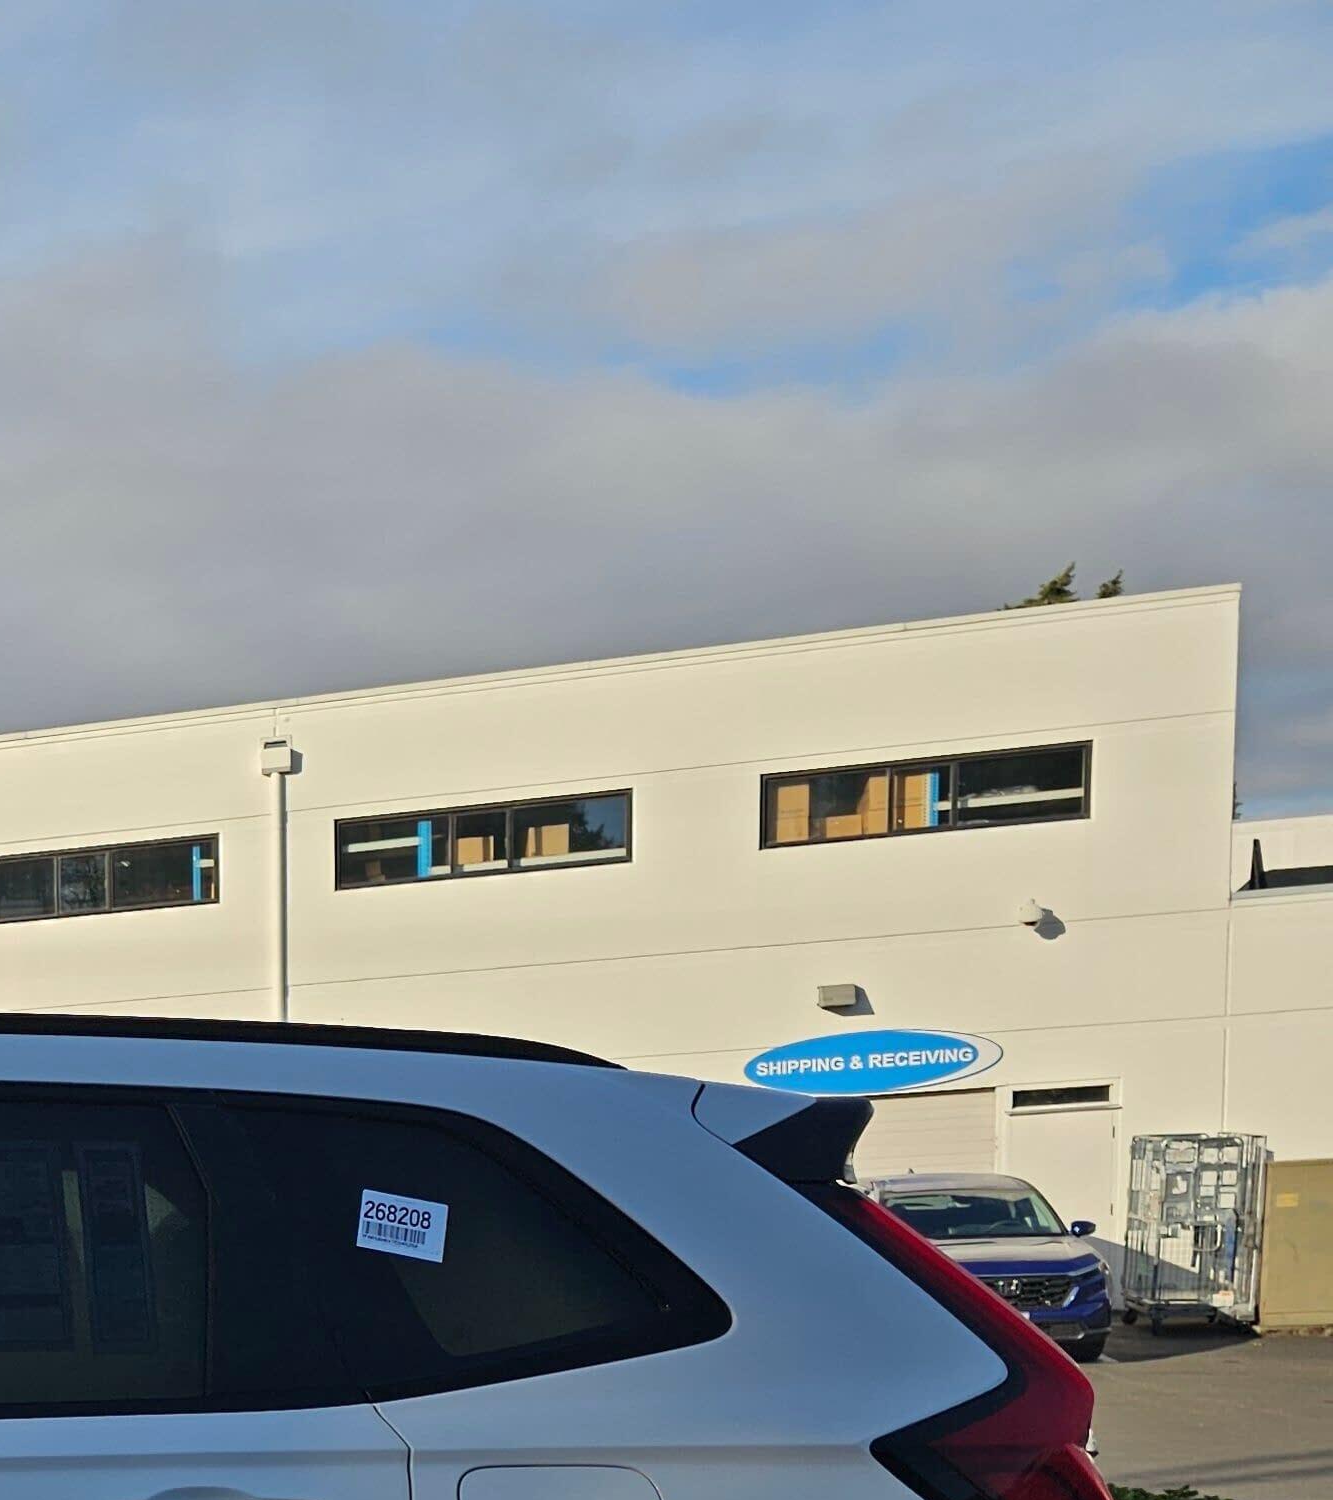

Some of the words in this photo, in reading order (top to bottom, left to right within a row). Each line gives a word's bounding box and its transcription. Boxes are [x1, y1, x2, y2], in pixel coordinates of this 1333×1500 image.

[755, 1056, 846, 1077] SHIPPING
[849, 1055, 864, 1070] &
[868, 1048, 974, 1068] RECEIVING
[363, 1200, 431, 1230] 268208
